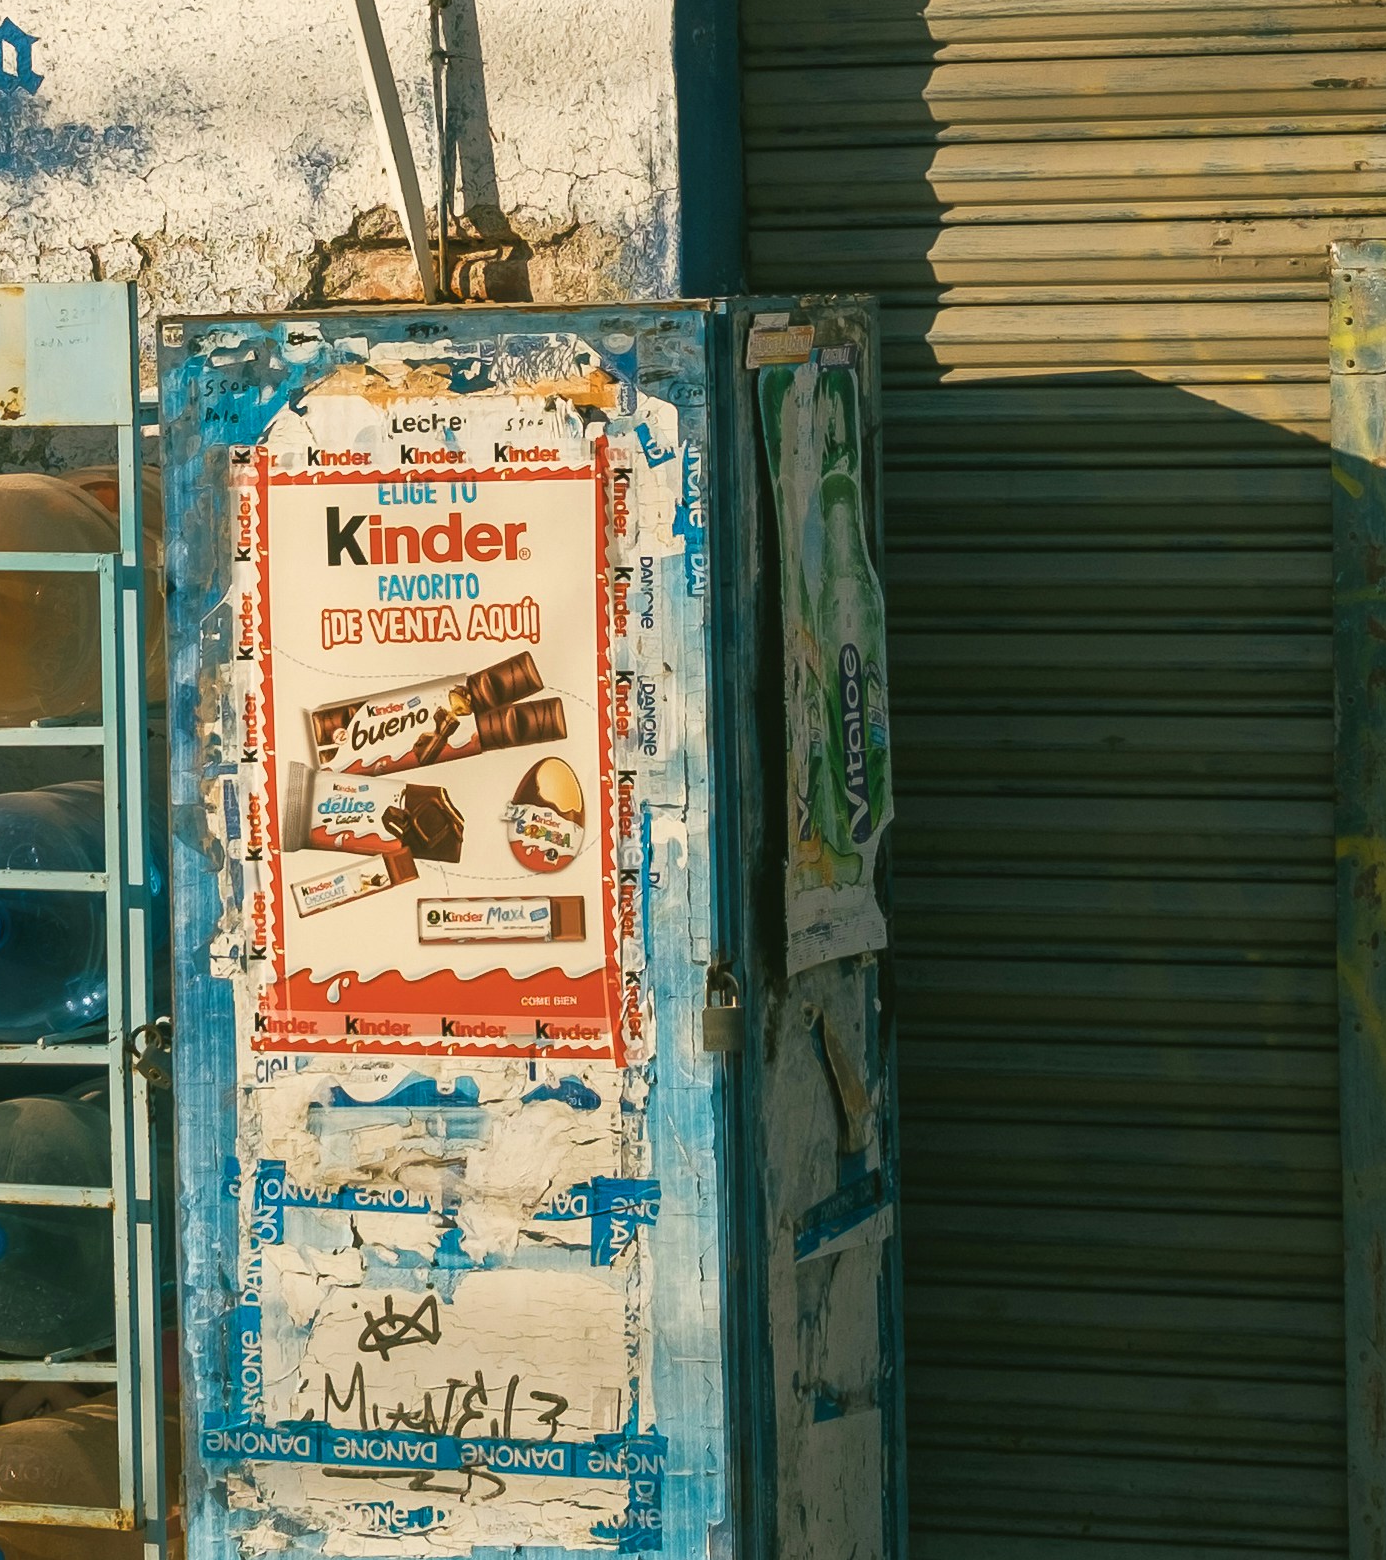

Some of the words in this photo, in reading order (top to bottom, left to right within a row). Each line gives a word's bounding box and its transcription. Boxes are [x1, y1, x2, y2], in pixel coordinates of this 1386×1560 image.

[378, 477, 438, 506] ELIGE
[447, 475, 478, 505] TU
[378, 572, 480, 602] FAVORITO
[367, 605, 462, 644] VENTA
[351, 707, 429, 751] bueno
[486, 905, 527, 925] Maxi
[521, 996, 551, 1007] COME
